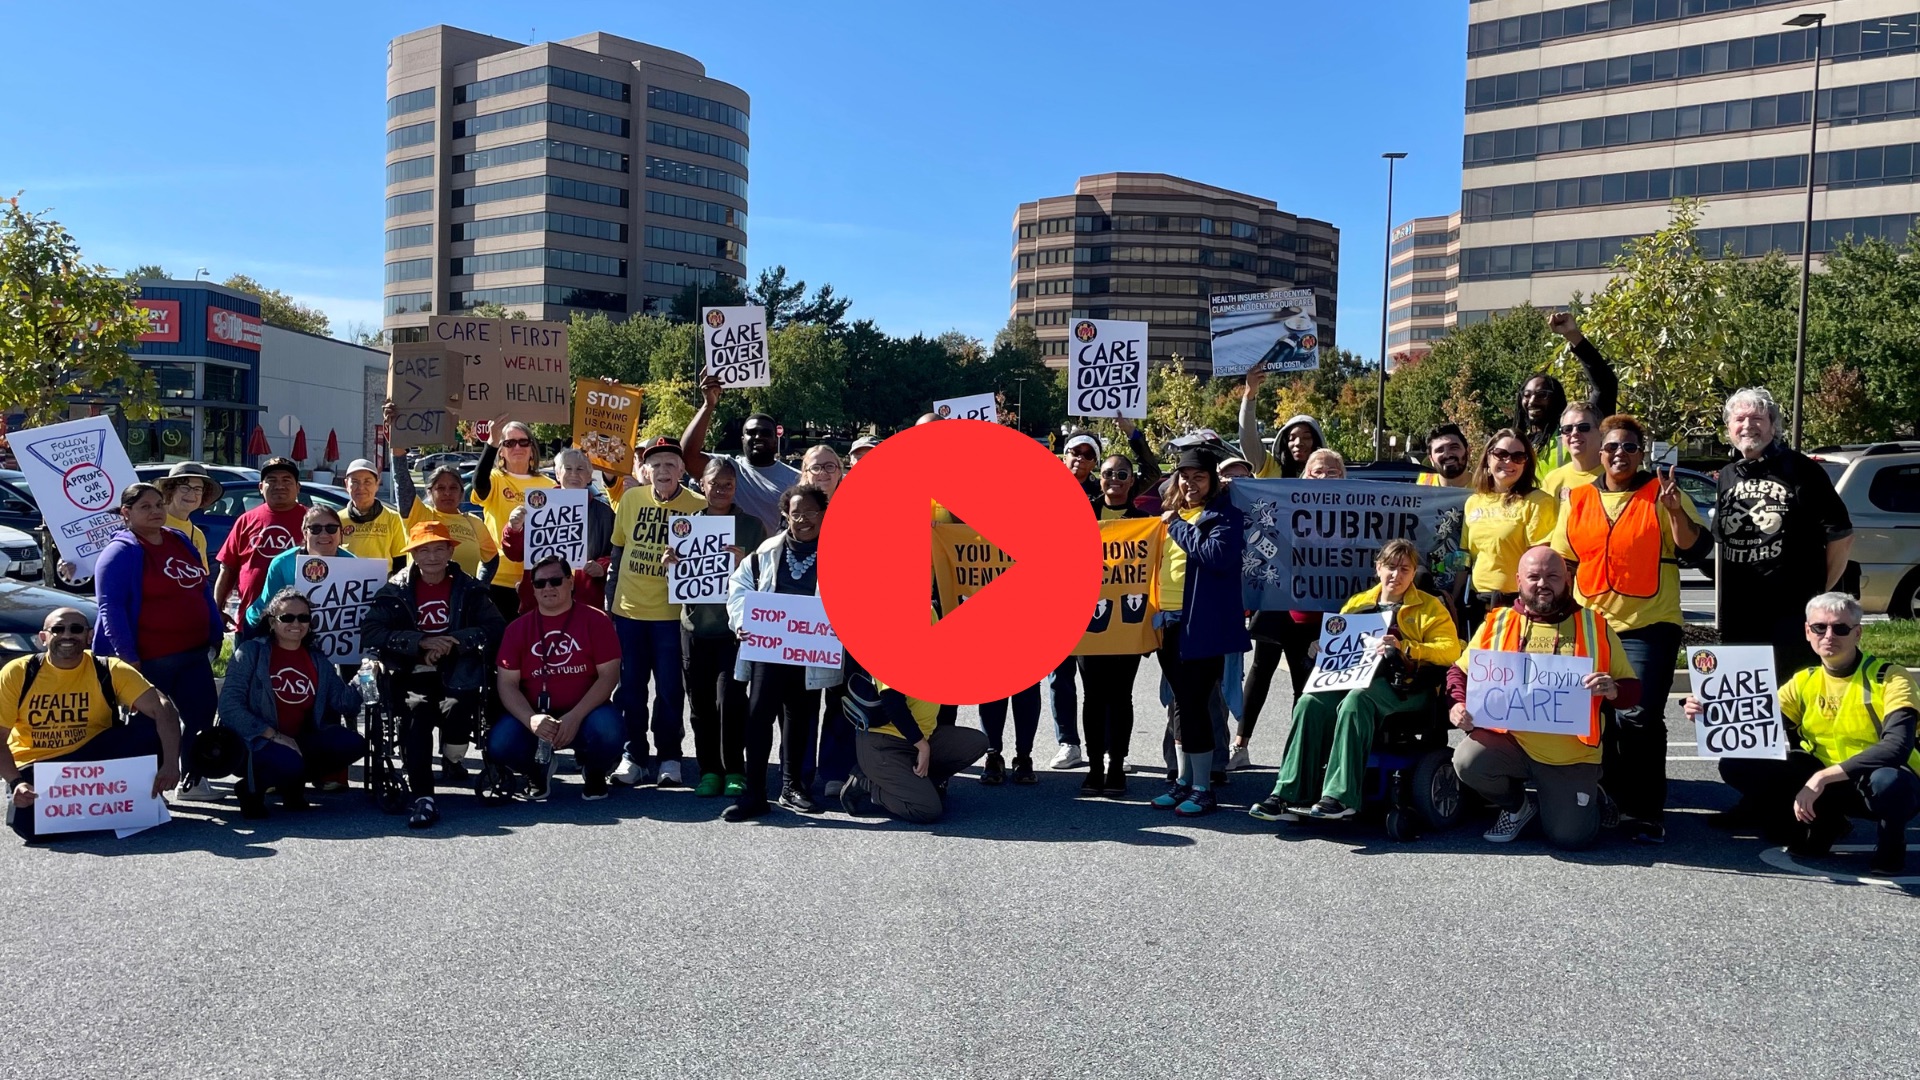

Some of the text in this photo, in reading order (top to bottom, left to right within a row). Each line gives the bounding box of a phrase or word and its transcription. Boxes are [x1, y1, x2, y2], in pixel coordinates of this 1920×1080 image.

[1212, 288, 1312, 305] HEALTH INSURERS ARE DENYING
[1212, 304, 1235, 314] CLAIMS
[1236, 303, 1251, 312] AND
[1251, 301, 1279, 311] DENYING
[1280, 299, 1294, 308] OUR
[436, 322, 562, 347] CARE FIRST
[711, 322, 762, 347] CARE
[713, 342, 761, 366] OVER
[1078, 340, 1140, 366] CARE
[394, 357, 441, 379] CARE
[503, 356, 563, 373] WEALTH
[714, 360, 766, 384] COST!
[1267, 361, 1282, 370] OVER
[1080, 363, 1136, 388] OVER
[506, 383, 565, 405] HEALTH
[587, 390, 631, 411] STOP
[1078, 384, 1141, 412] COST!
[585, 407, 628, 423] DENYING
[477, 423, 489, 434] STO
[584, 418, 626, 434] US CARE
[51, 436, 89, 452] FOLLOW
[62, 452, 96, 467] ORDERS
[66, 470, 104, 489] APPROVE
[84, 481, 102, 493] OUR
[80, 490, 110, 505] CARE
[1291, 492, 1422, 508] COVER OUR CARE
[531, 504, 584, 528] CARE
[1291, 509, 1419, 541] CUBRIR
[66, 522, 84, 536] WE
[532, 524, 581, 546] OVER
[633, 523, 669, 544] CAR
[250, 535, 297, 550] CASA
[675, 533, 730, 558] CARE
[631, 549, 656, 561] HUMAN
[954, 544, 991, 563] YOU
[677, 554, 727, 578] OVER
[306, 578, 378, 608] CARE
[675, 573, 729, 600] COST!
[312, 604, 371, 632] OVER
[751, 608, 786, 622] STOP
[531, 638, 582, 657] CASA
[748, 634, 841, 665] STOP DENIALS
[1322, 652, 1376, 672] OVER
[1470, 653, 1514, 686] Stop
[1313, 664, 1373, 688] COST!
[1700, 668, 1769, 701] CARE
[28, 692, 89, 710] HEALTH
[1484, 687, 1574, 723] CARE
[1706, 697, 1771, 725] OVER
[31, 730, 62, 740] HUMAN
[1706, 720, 1778, 753] COST!
[61, 766, 104, 779] STOP
[49, 780, 128, 799] DENYING
[45, 800, 134, 818] OUR CARE
